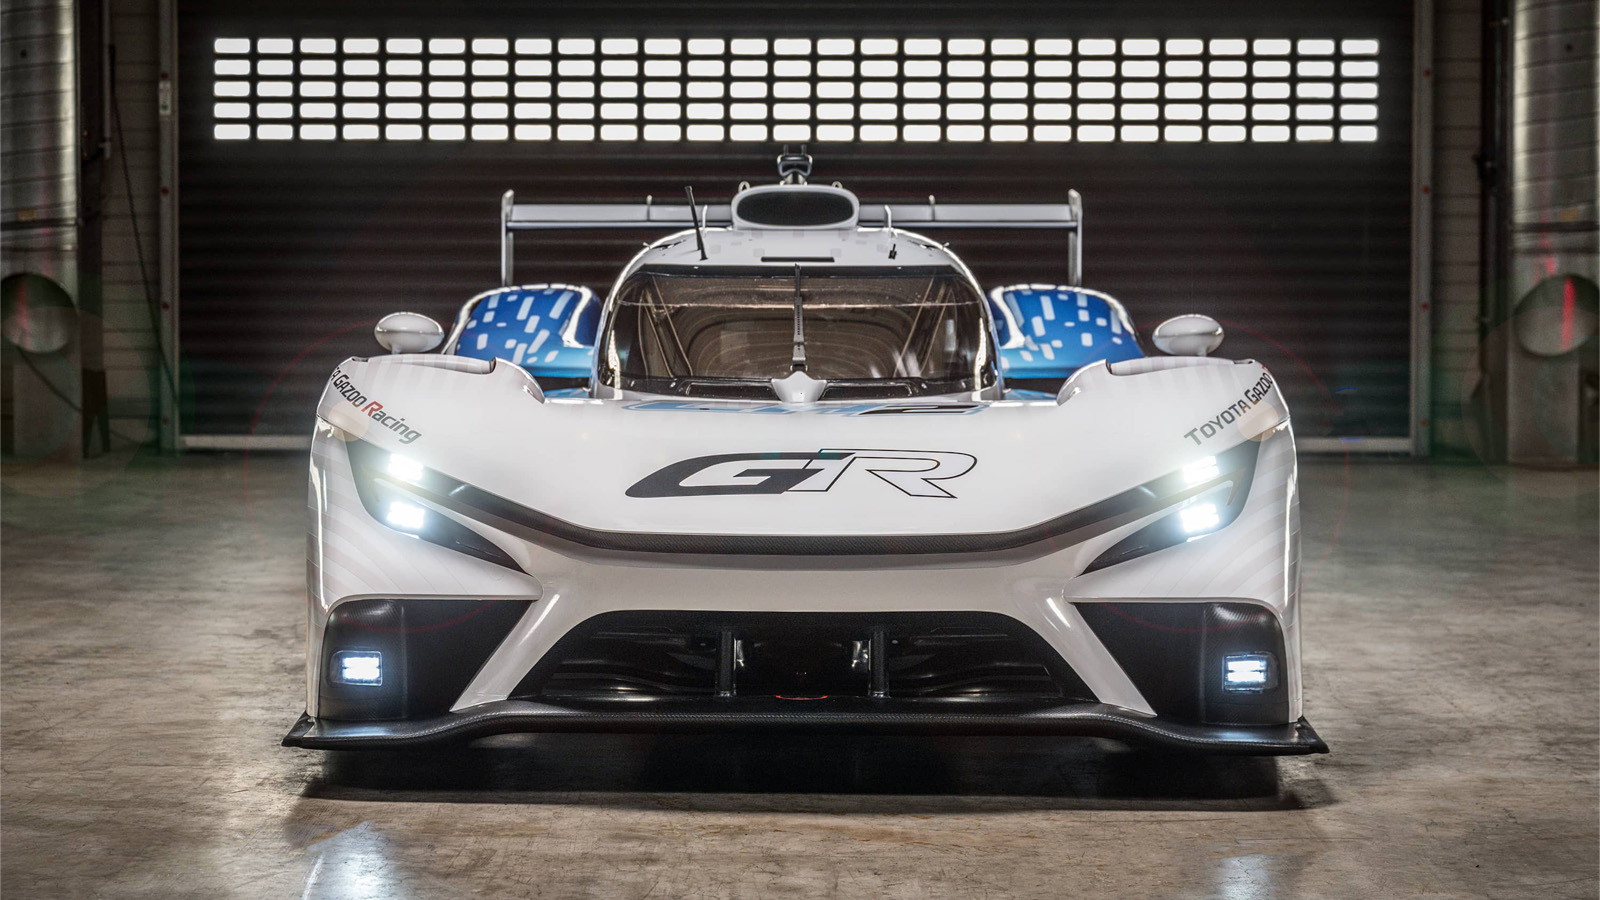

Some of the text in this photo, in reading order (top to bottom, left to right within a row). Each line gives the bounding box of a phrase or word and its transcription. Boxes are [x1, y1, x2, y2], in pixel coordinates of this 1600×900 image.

[333, 374, 367, 407] GAZOO
[361, 400, 422, 444] Racing
[1184, 399, 1251, 446] TOYOTA
[625, 448, 978, 499] GR
